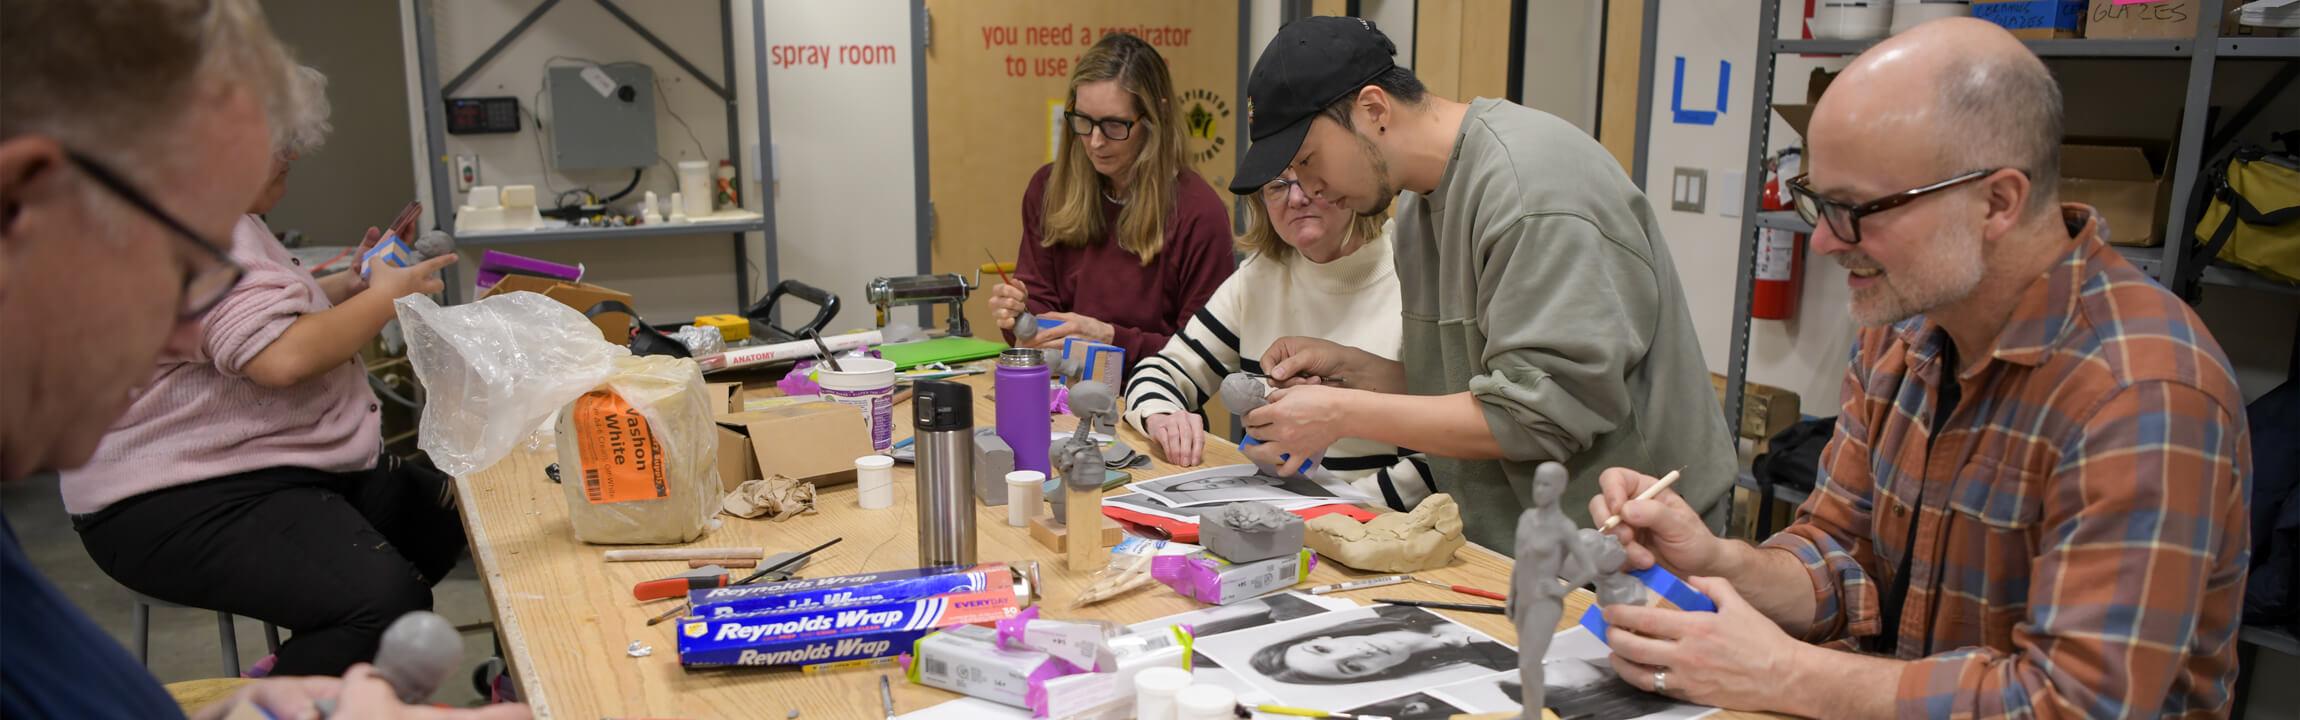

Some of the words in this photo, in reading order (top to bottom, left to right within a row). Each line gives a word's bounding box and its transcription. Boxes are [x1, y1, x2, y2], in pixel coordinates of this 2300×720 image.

[2091, 3, 2188, 23] GLAZES
[981, 26, 1018, 49] you
[1025, 23, 1073, 46] need
[1080, 27, 1091, 46] a
[771, 44, 831, 69] spray
[839, 44, 896, 65] room
[1005, 55, 1027, 77] to
[1034, 56, 1068, 77] use
[733, 352, 775, 365] ANATOMY
[604, 413, 626, 465] White
[625, 407, 646, 471] Vashon
[706, 579, 813, 599] Reynolds
[817, 575, 877, 586] Wrap
[954, 598, 1009, 609] EVERYDAY
[714, 615, 834, 642] Reynolds
[835, 609, 903, 629] Wrap
[737, 642, 833, 666] Reynolds
[833, 637, 890, 657] Wrap
